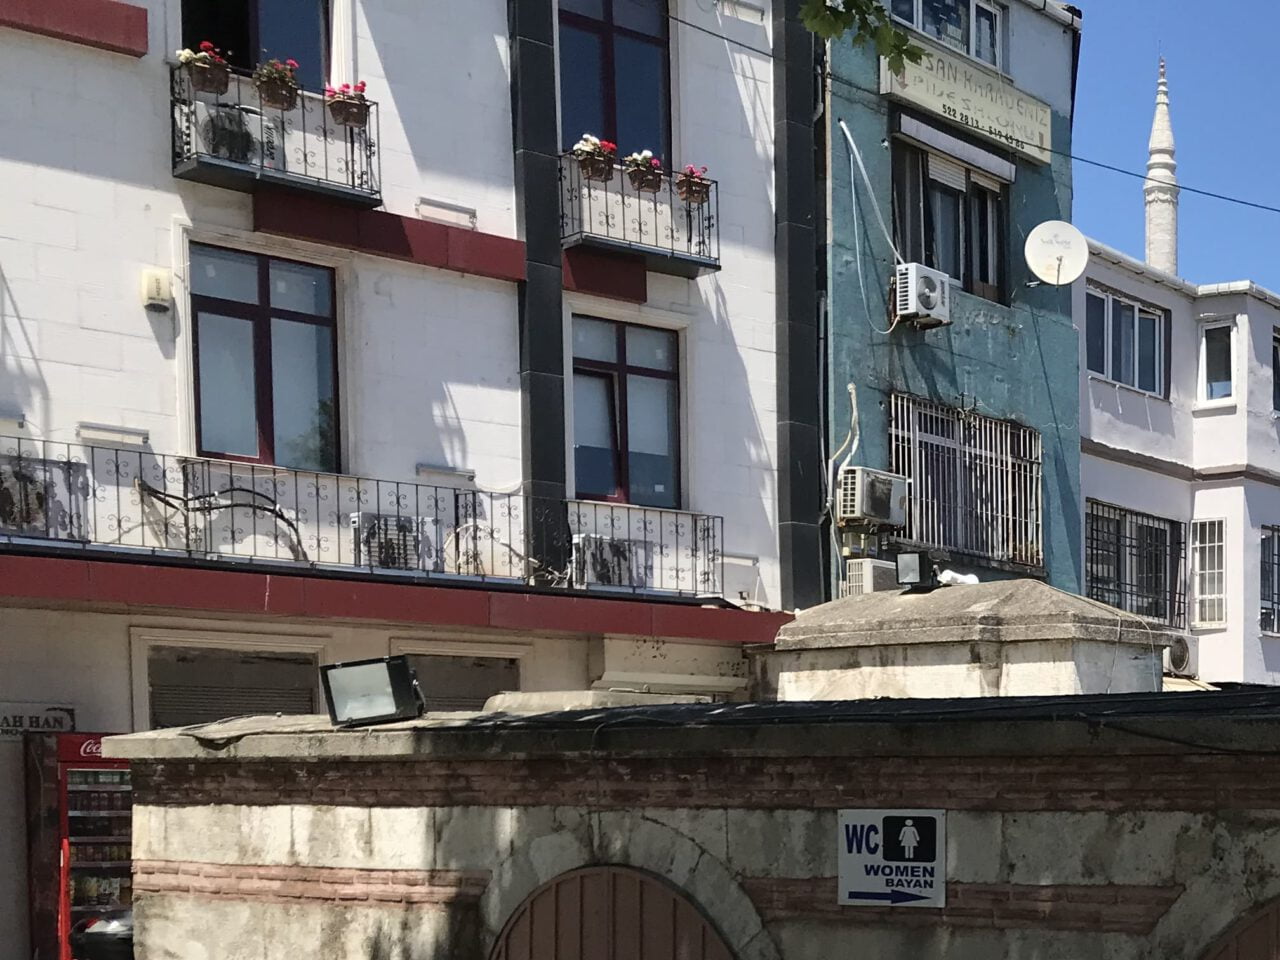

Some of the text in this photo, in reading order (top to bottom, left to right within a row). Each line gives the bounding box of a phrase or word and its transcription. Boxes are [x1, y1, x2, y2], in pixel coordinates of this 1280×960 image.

[942, 103, 957, 118] 522
[29, 715, 64, 729] HAN
[845, 823, 880, 855] WC
[864, 864, 935, 878] WOMEN
[885, 878, 934, 889] BAYAN
